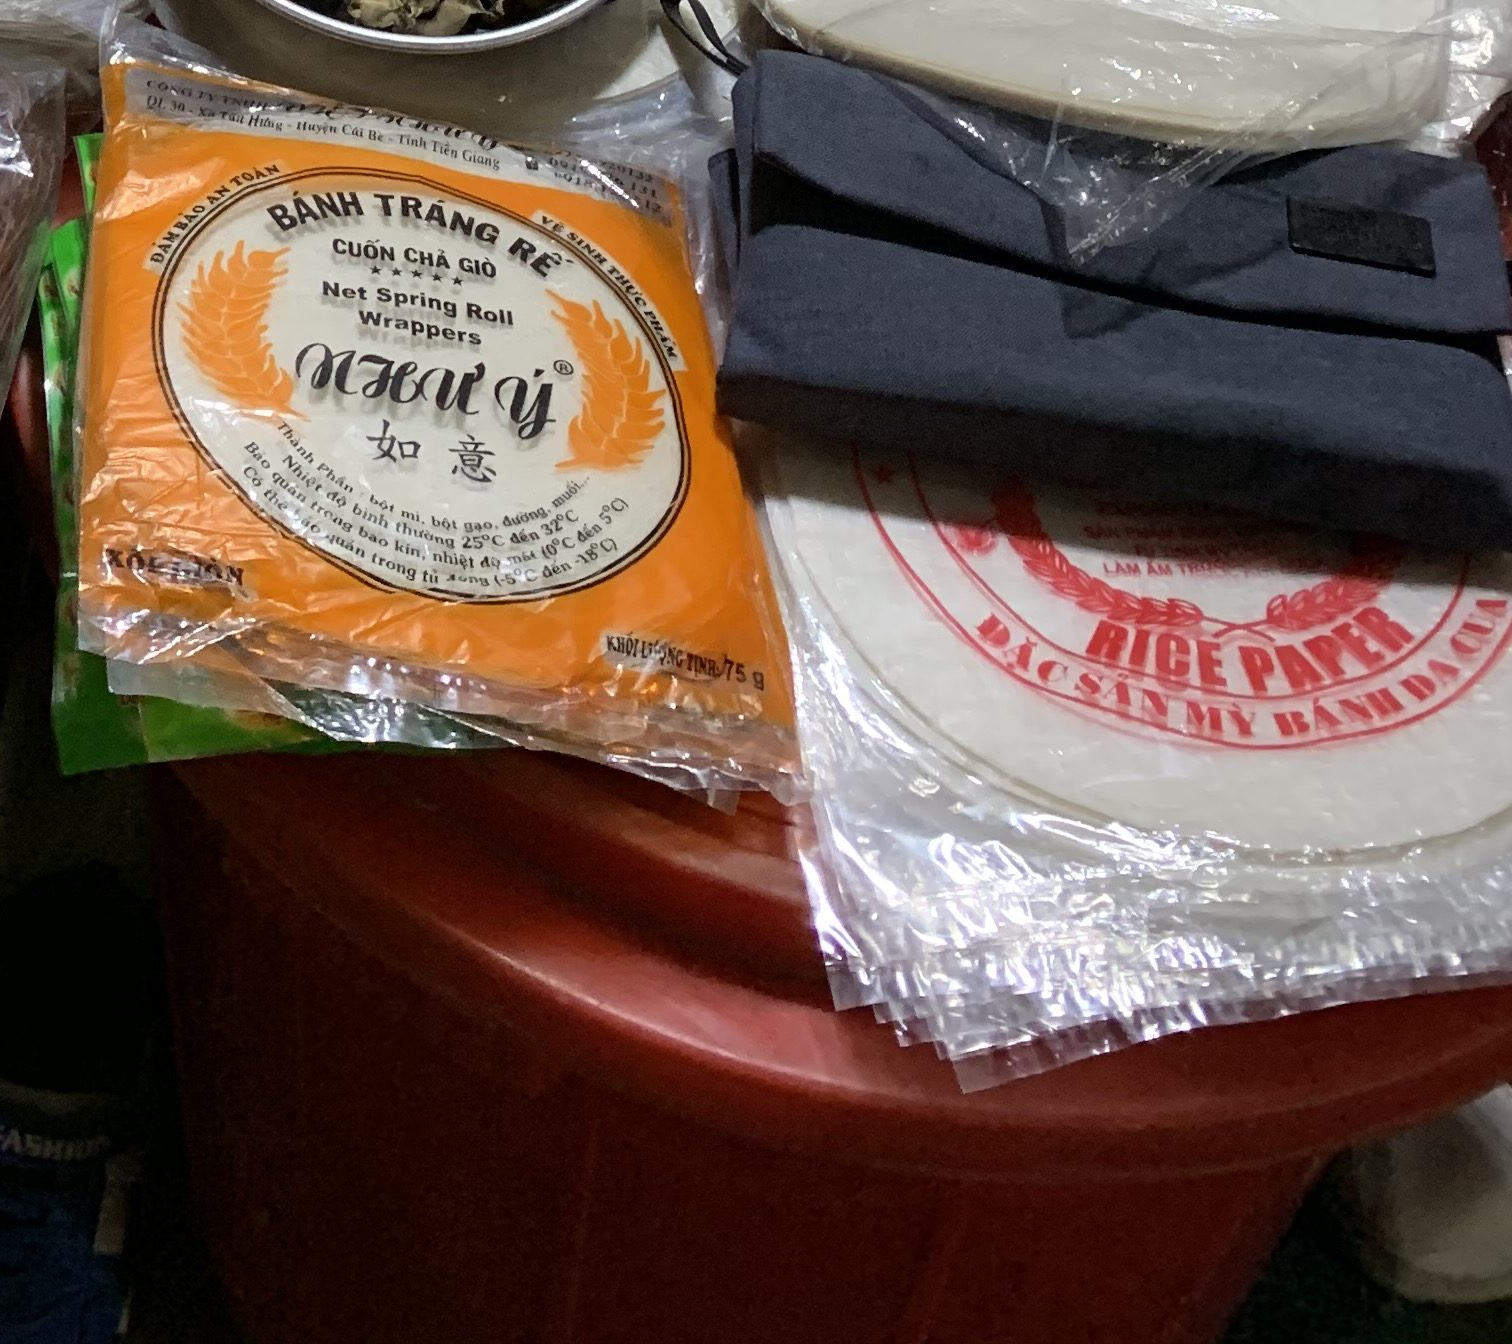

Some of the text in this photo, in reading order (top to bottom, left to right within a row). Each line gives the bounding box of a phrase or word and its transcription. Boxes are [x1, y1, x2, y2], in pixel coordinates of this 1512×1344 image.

[206, 183, 232, 204] AN
[229, 162, 282, 188] TOÀN
[266, 189, 365, 232] BÁNH
[373, 193, 501, 246] TRÁNG
[331, 237, 497, 279] CUỐN CHẢ GIÒ
[321, 280, 514, 327] Net Spring Roll
[566, 227, 609, 266] SINH
[607, 264, 648, 308] THỰC
[643, 310, 679, 359] PHẨM
[358, 309, 483, 346] Wrappers
[275, 420, 316, 466] Thành
[369, 492, 396, 512] bột
[430, 514, 458, 531] bột
[366, 418, 497, 483] 如意
[605, 631, 638, 658] KHỐI
[724, 654, 747, 683] 75
[752, 671, 765, 691] g
[974, 612, 1070, 686] ĐẶC
[1074, 669, 1170, 721] SẢN
[1272, 686, 1405, 739] BÁNH
[1084, 605, 1417, 695] RICE PAPER
